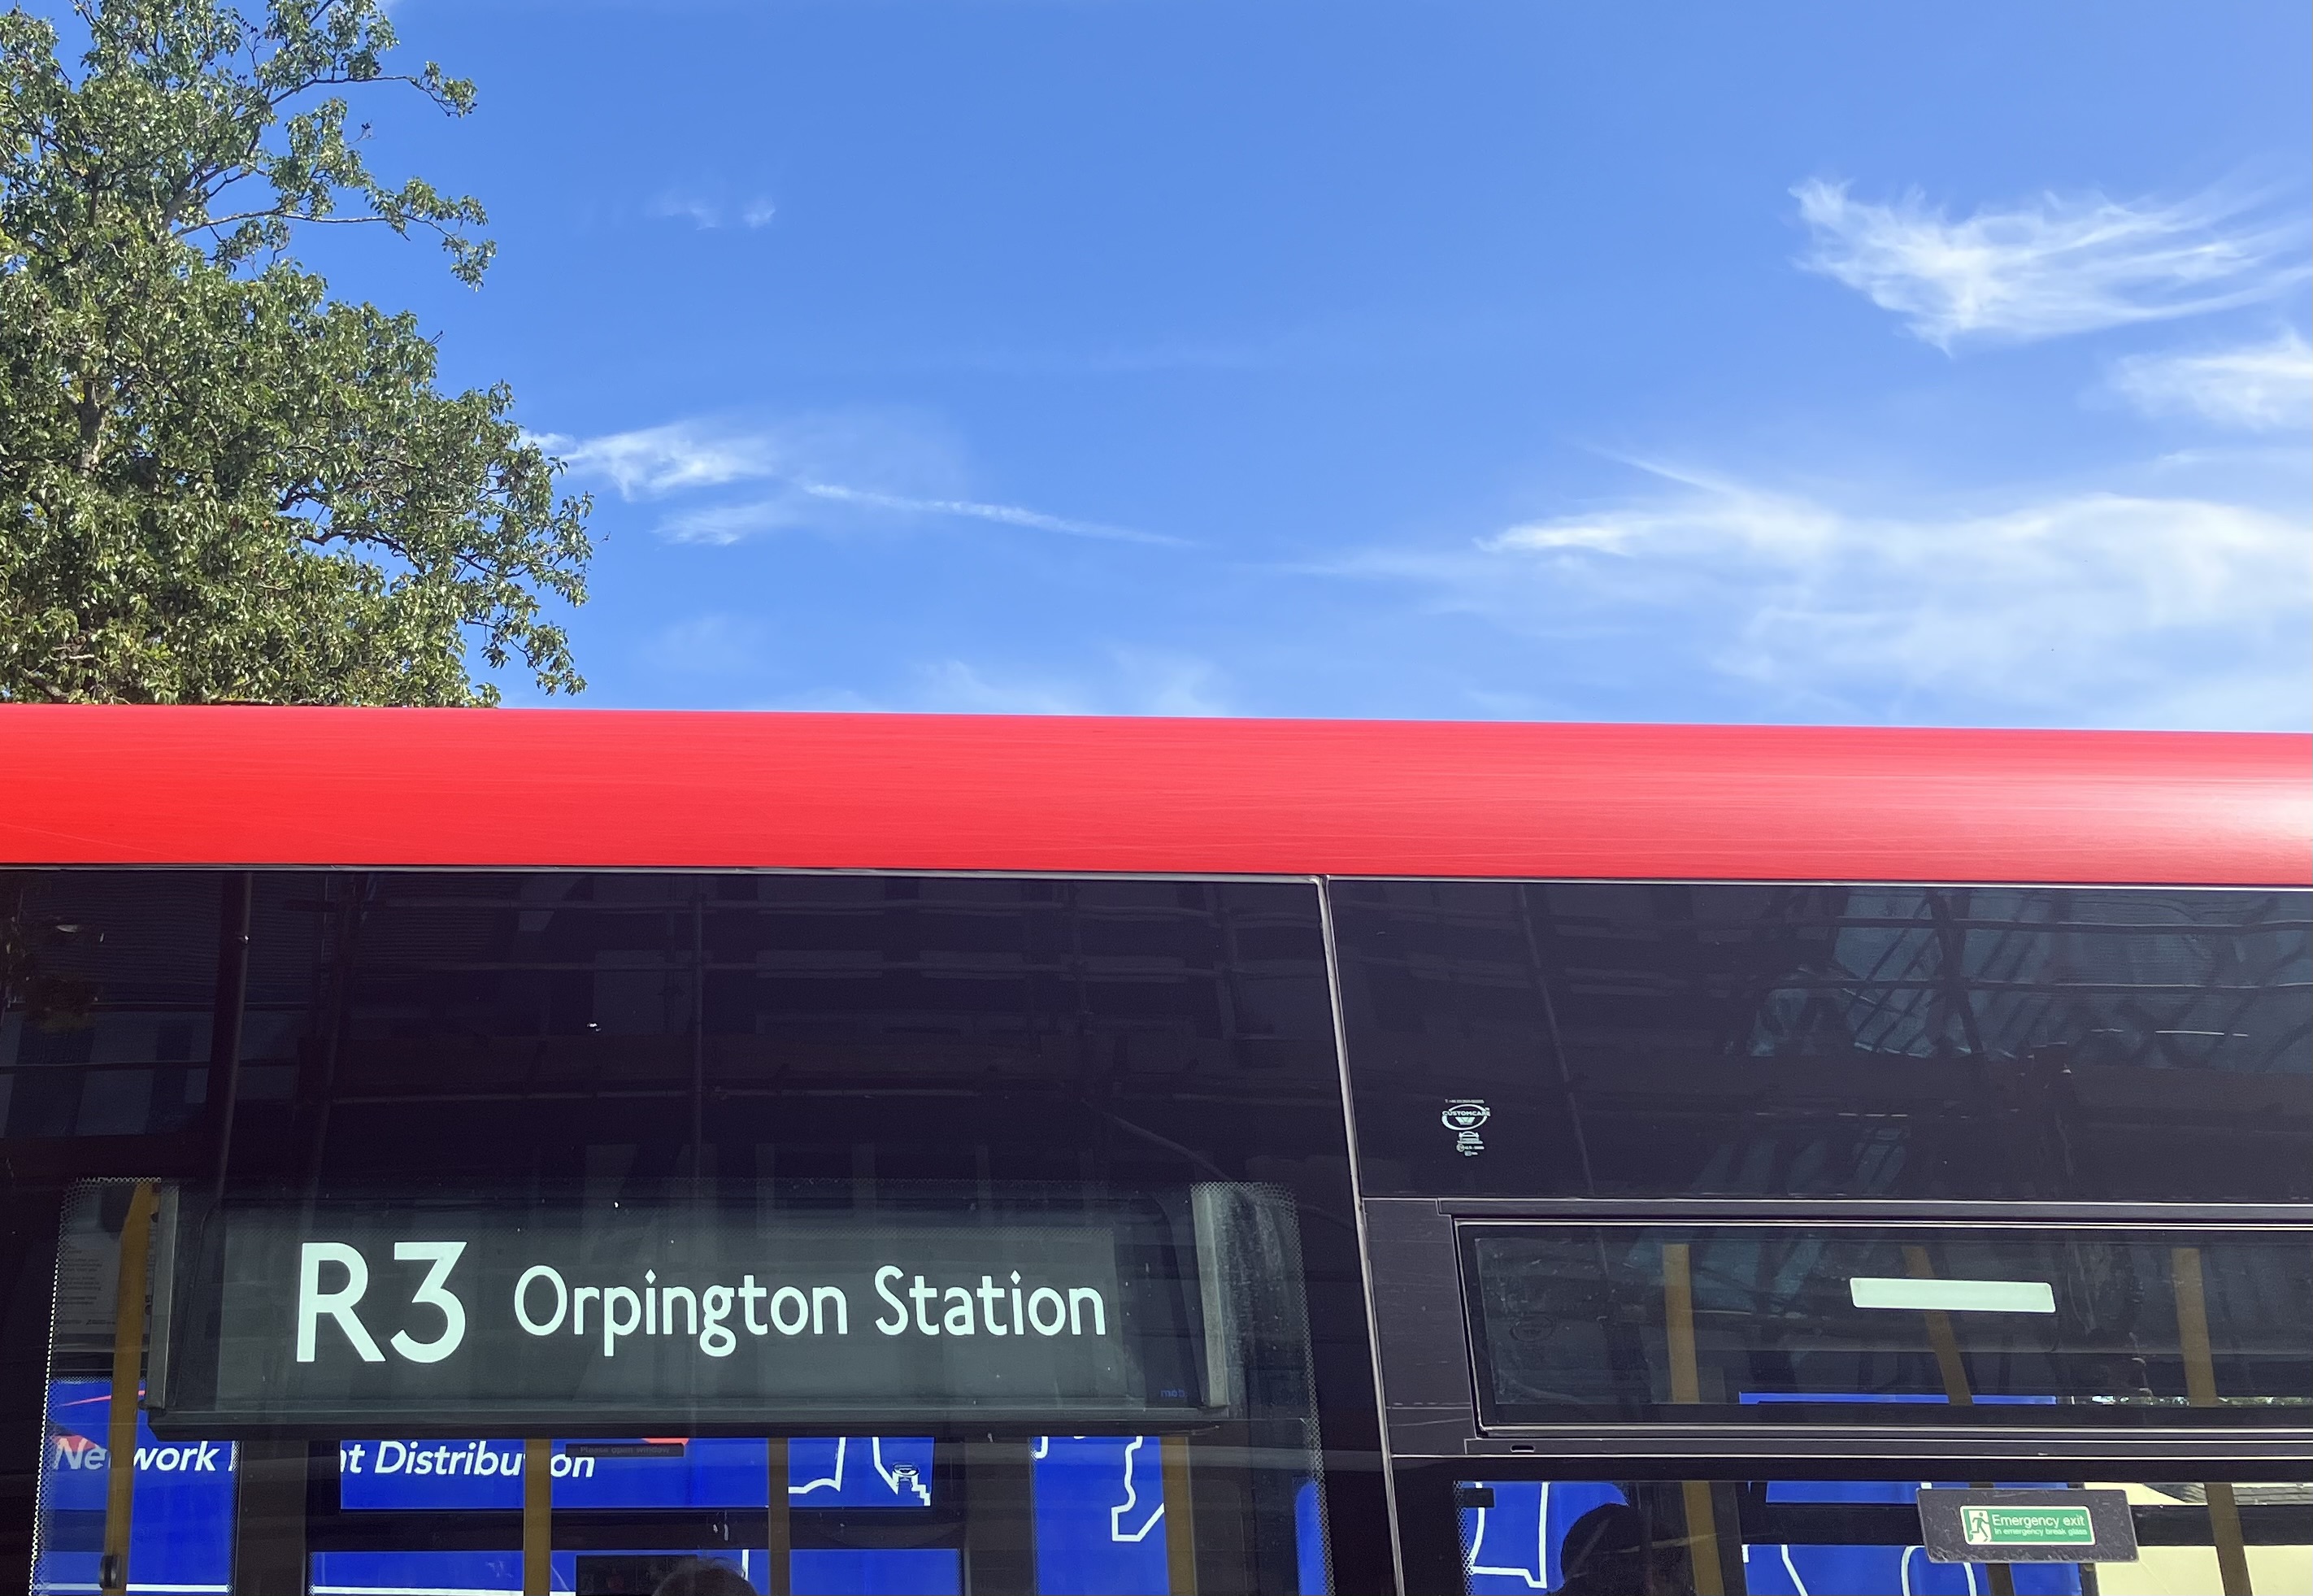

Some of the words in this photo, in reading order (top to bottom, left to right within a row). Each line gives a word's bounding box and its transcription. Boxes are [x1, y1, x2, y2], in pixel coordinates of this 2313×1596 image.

[297, 1242, 467, 1363] R3
[514, 1265, 848, 1357] Orpington
[875, 1265, 1107, 1337] Station
[54, 1437, 220, 1472] Nework
[375, 1440, 595, 1478] Distribuon
[580, 1446, 608, 1454] Please
[637, 1446, 671, 1454] window
[1992, 1514, 2059, 1529] Emergency
[2063, 1513, 2085, 1527] exit
[2003, 1529, 2044, 1537] emergency
[2069, 1529, 2088, 1537] glass
